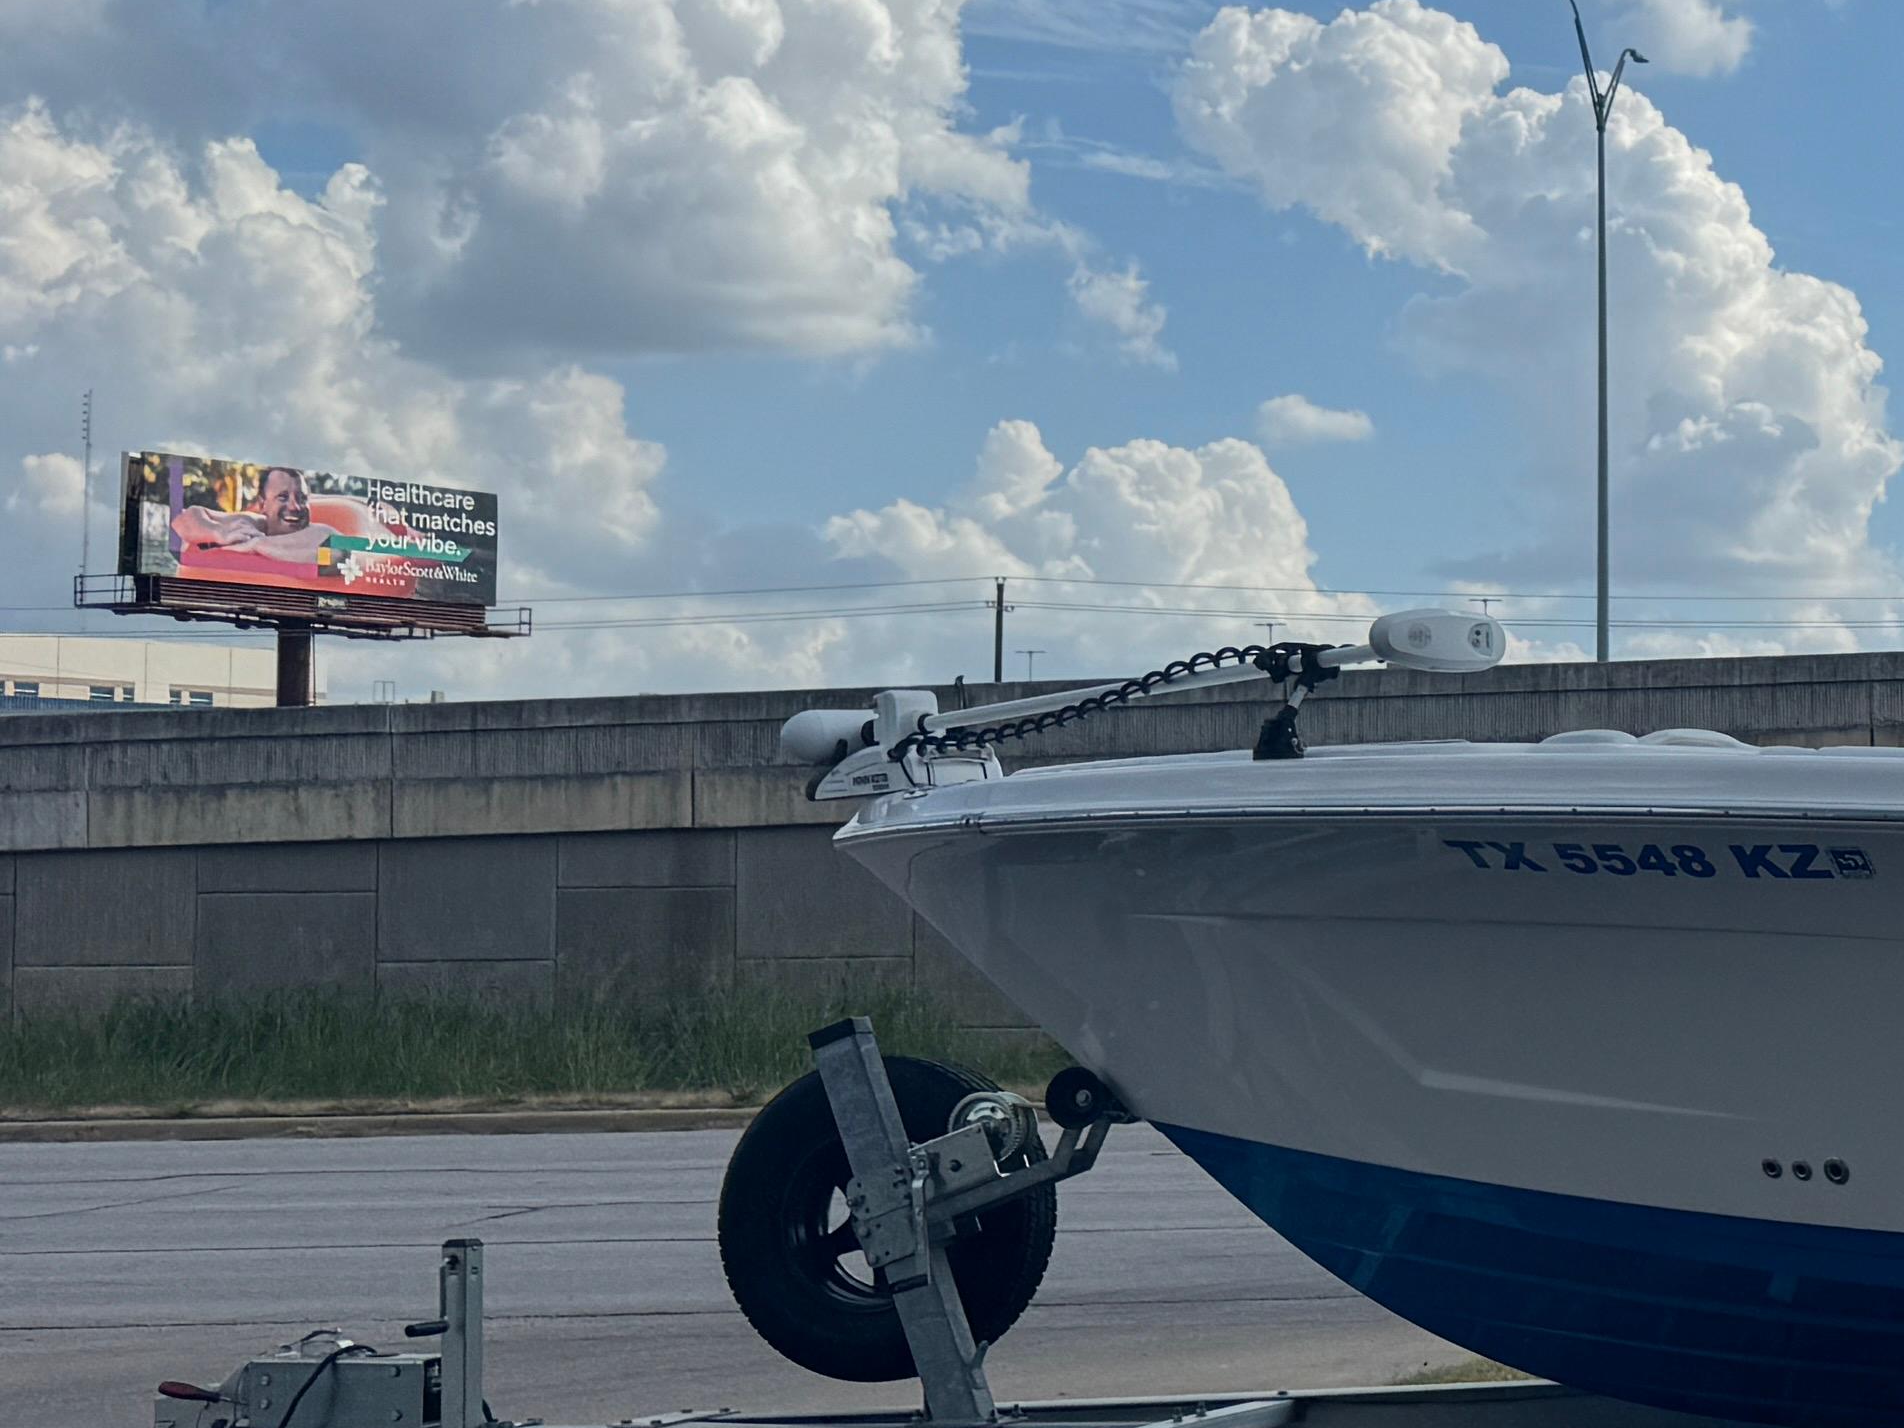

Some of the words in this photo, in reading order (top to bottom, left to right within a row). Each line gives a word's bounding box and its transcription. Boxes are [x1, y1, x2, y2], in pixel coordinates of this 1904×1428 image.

[367, 480, 475, 510] Healthcare
[367, 500, 408, 527] that
[412, 512, 496, 536] matches
[366, 533, 408, 551] your
[415, 533, 461, 556] vibe.
[1442, 839, 1548, 873] TX
[1553, 842, 1717, 879] 5548
[1728, 843, 1836, 880] KZ
